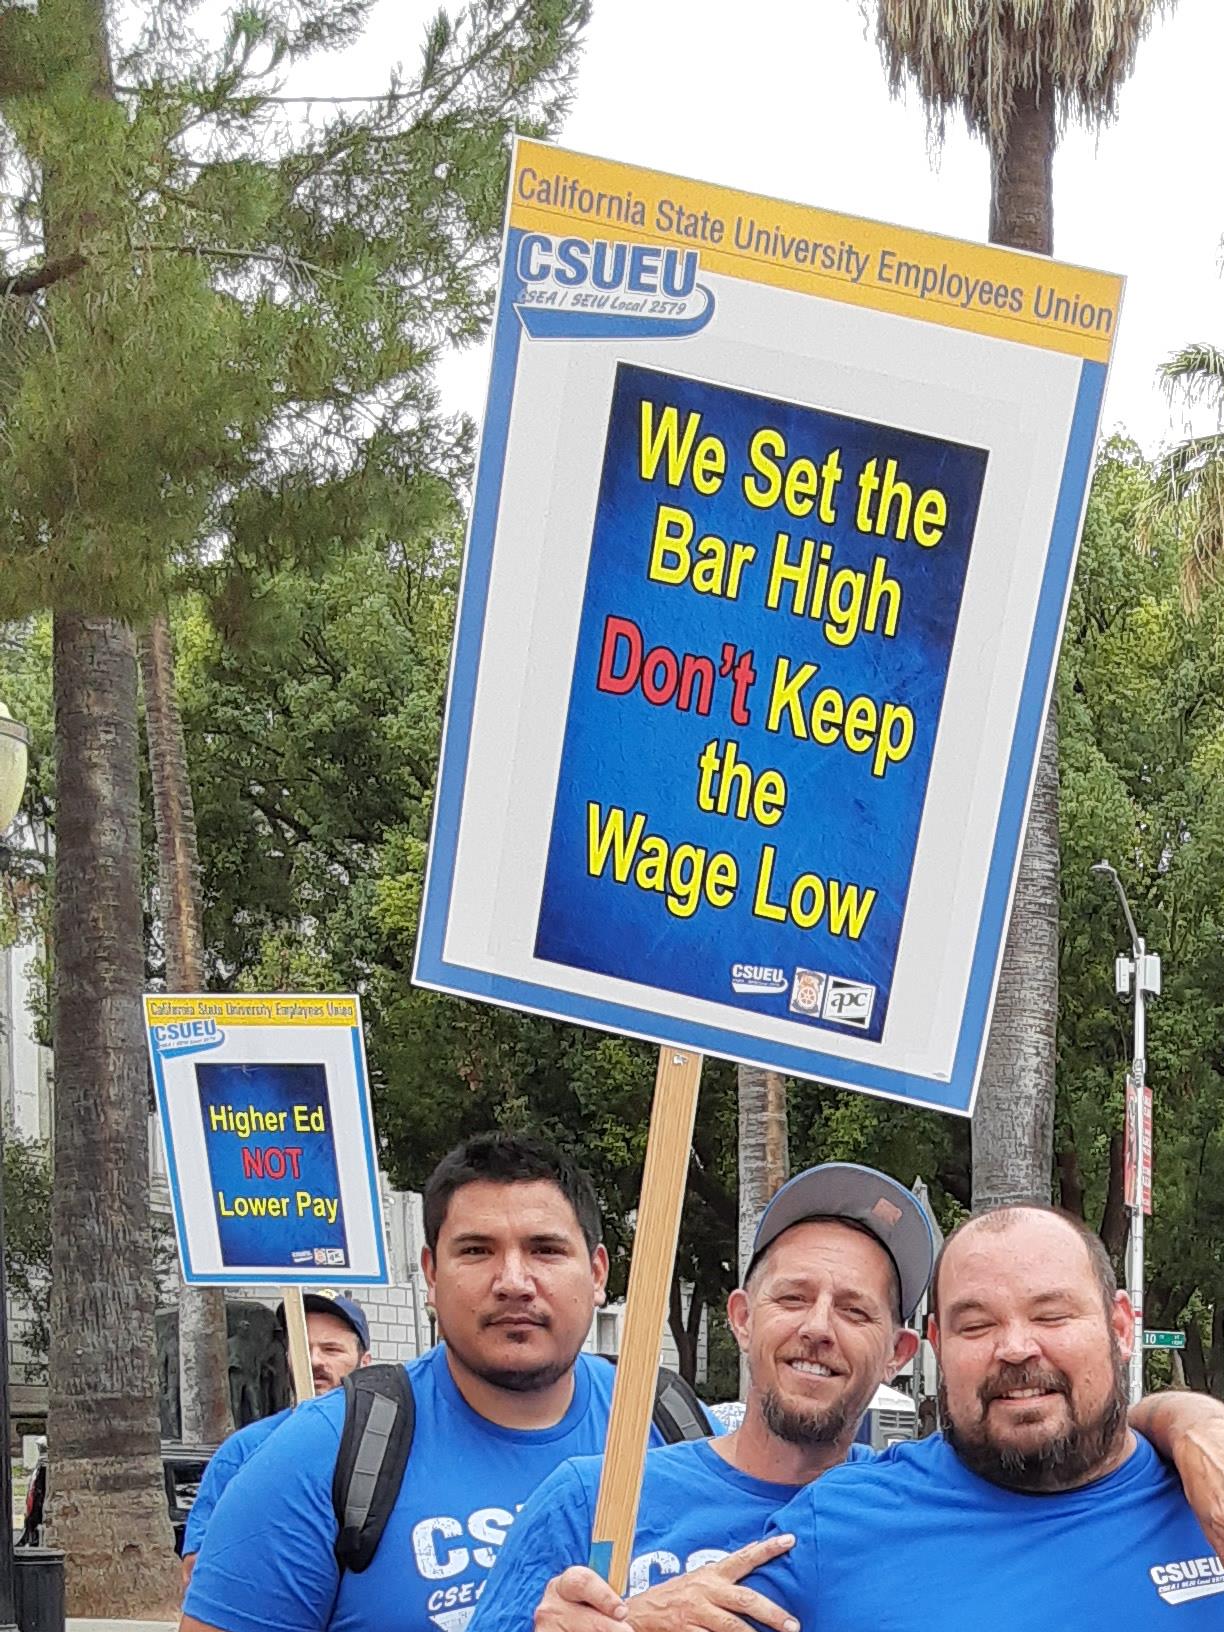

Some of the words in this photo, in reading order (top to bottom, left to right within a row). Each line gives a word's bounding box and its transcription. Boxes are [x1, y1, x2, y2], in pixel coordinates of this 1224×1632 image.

[518, 167, 646, 227] California
[656, 199, 724, 244] State
[733, 216, 870, 282] University
[878, 251, 1023, 313] Employees
[1035, 287, 1113, 334] Union
[519, 234, 698, 298] CSUEU
[571, 292, 608, 308] SEIU
[610, 296, 644, 313] Local
[648, 301, 687, 316] 2579
[639, 400, 726, 495] We
[743, 427, 842, 524] Set
[857, 455, 948, 549] the
[649, 504, 756, 599] Bar
[766, 531, 904, 648] High
[597, 615, 757, 726] Don't
[767, 657, 916, 776] Keep
[696, 739, 787, 827] the
[586, 802, 738, 919] Wage
[752, 844, 878, 940] Low
[732, 964, 784, 982] CSUEU
[831, 991, 868, 1013] apc
[155, 1019, 216, 1041] CSUEU
[209, 1105, 287, 1138] Higher
[294, 1105, 325, 1132] Ed
[241, 1148, 303, 1180] NOT
[218, 1192, 289, 1217] Lower
[296, 1192, 338, 1223] Pay
[1145, 1334, 1156, 1344] 10
[412, 1503, 527, 1580] CS
[1151, 1556, 1224, 1585] CSUEU
